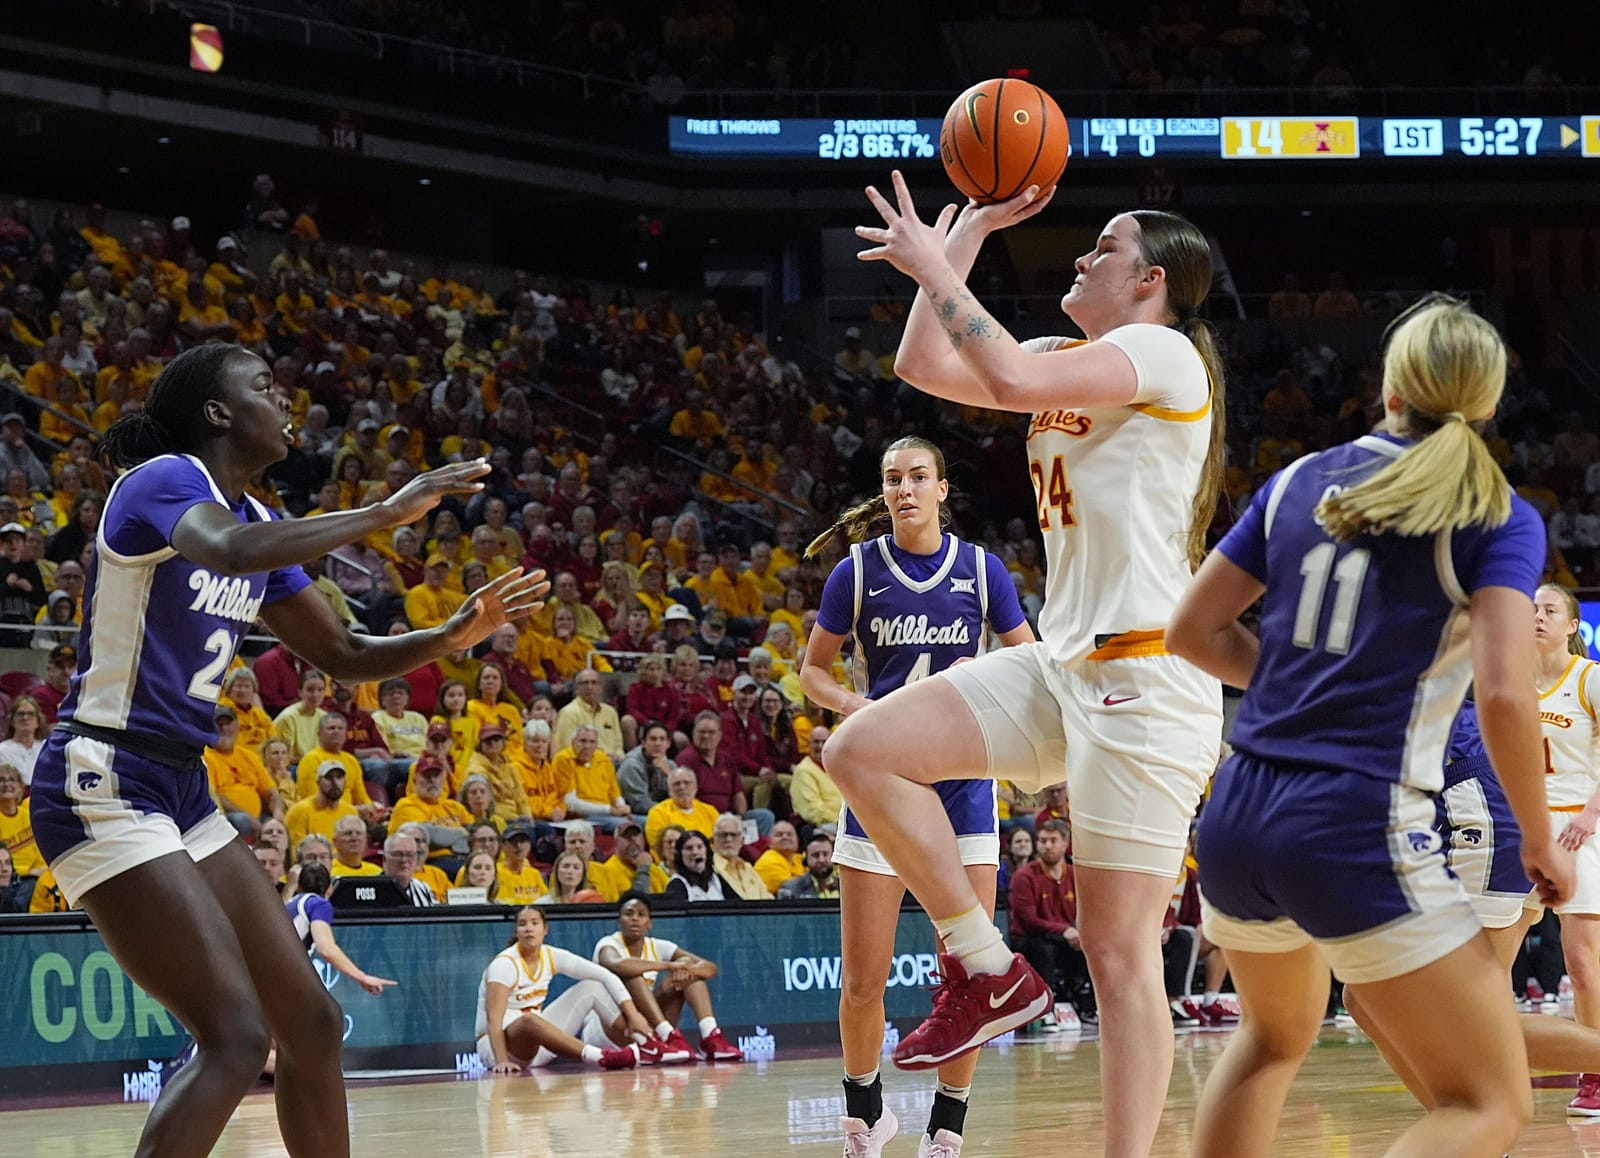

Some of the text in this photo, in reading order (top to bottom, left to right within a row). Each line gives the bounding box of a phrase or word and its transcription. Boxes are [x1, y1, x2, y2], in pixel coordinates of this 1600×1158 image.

[686, 119, 781, 134] FREE THROWS
[834, 120, 917, 133] 3 POINTERS
[1170, 119, 1216, 132] BONUS
[1236, 119, 1283, 155] 14
[1393, 126, 1433, 148] 1ST
[1459, 118, 1543, 155] 5:27
[332, 128, 357, 149] 114
[819, 134, 859, 159] 2/3
[862, 134, 935, 158] 66.7%
[1100, 135, 1119, 157] 4
[1138, 135, 1156, 157] 0
[1031, 455, 1077, 531] 24
[1292, 542, 1371, 656] 11
[870, 614, 970, 647] Wildcats
[904, 652, 933, 687] 4
[355, 887, 377, 901] POSS
[783, 957, 841, 990] IOW
[31, 951, 191, 1043] COR
[455, 1053, 480, 1071] LAN
